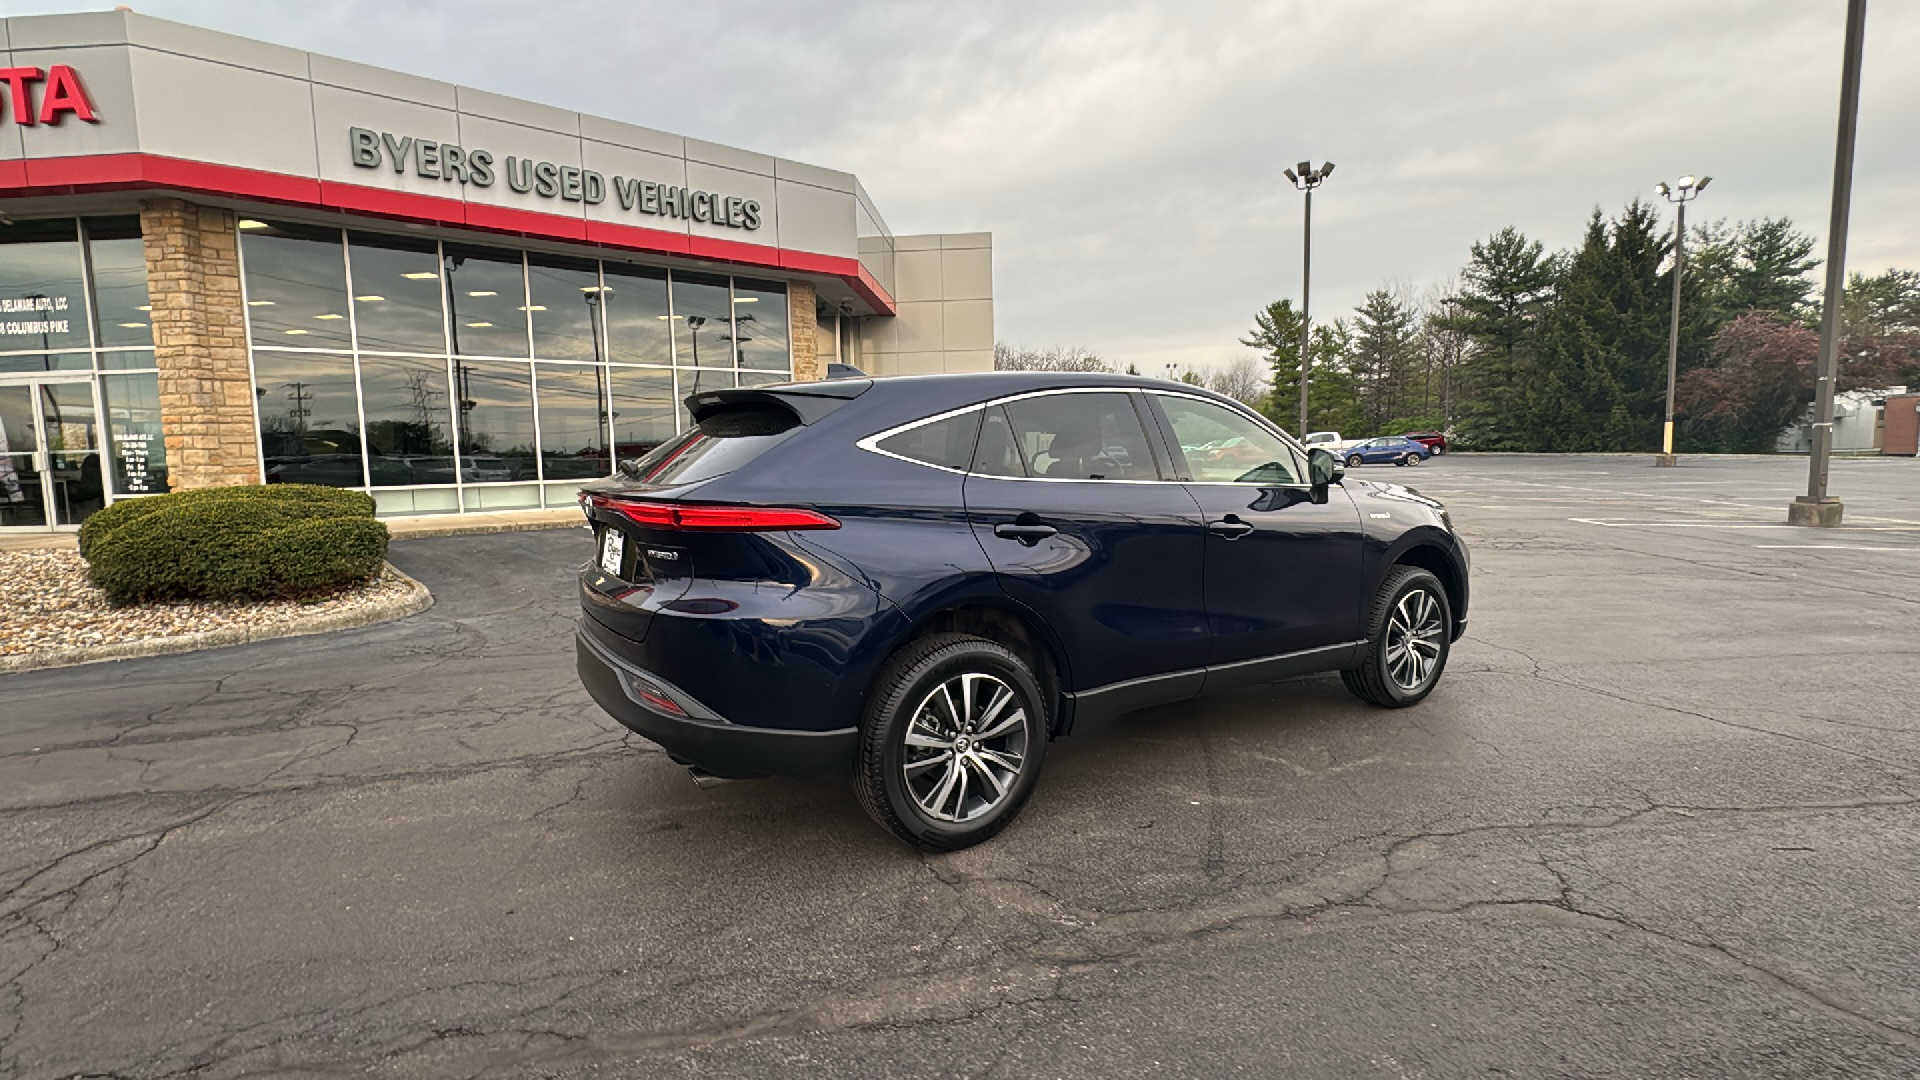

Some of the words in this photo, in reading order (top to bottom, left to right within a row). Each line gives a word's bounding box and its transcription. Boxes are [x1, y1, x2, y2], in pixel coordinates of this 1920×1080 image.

[0, 64, 97, 126] TA
[350, 126, 496, 188] BYERS
[506, 155, 607, 204] USED
[614, 175, 762, 230] VEHICLES
[6, 321, 49, 335] COLUMBUS
[50, 319, 70, 333] PIKE
